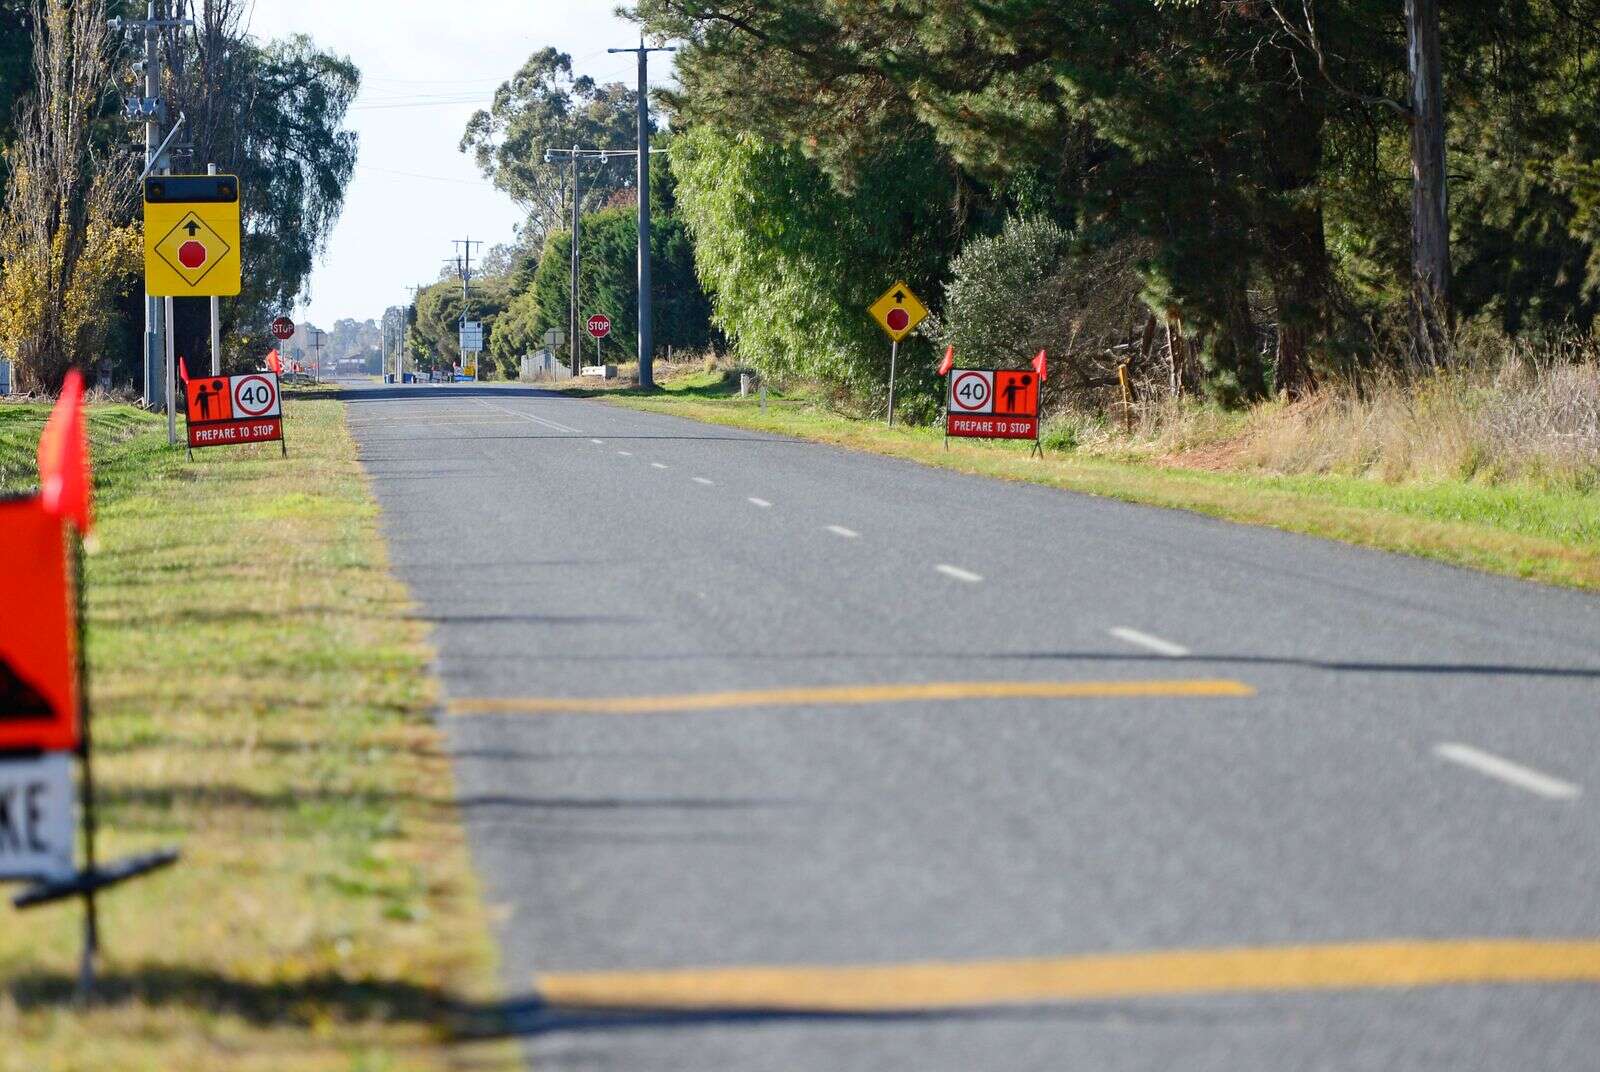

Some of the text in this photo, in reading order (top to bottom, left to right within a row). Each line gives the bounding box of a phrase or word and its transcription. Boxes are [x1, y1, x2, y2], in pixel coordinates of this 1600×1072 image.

[273, 324, 294, 333] STOP
[589, 321, 609, 330] STOP
[242, 386, 269, 405] 40
[960, 383, 985, 400] 40
[195, 424, 274, 441] PREPARE TO STOP
[954, 420, 1031, 434] PREPARE TO STOP
